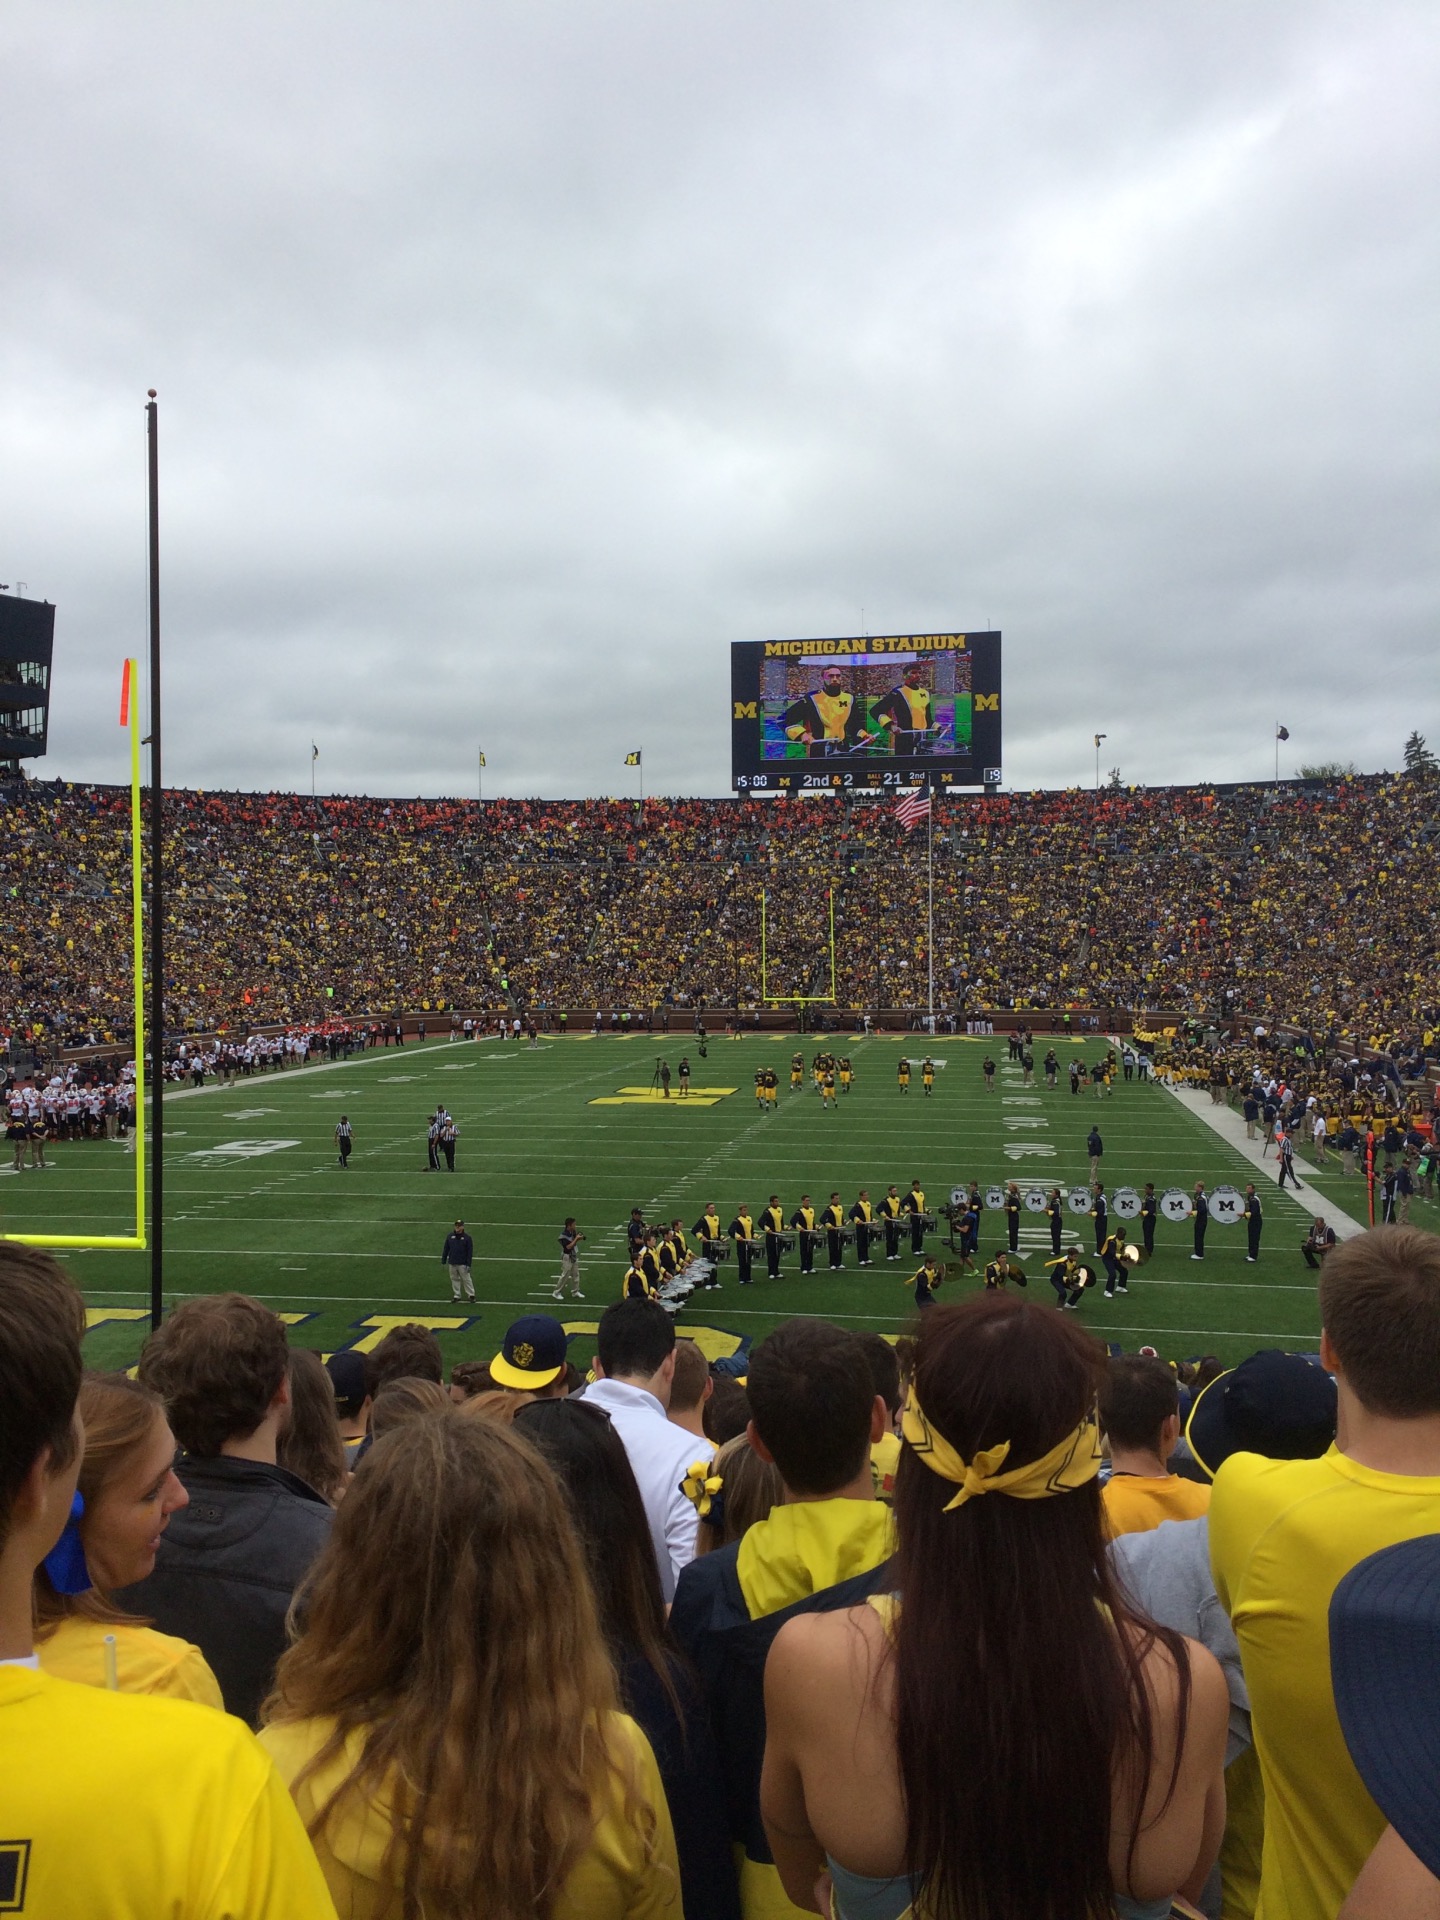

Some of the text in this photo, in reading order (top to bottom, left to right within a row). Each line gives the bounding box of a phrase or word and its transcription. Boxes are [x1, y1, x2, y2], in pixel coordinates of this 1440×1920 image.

[765, 634, 966, 656] MICHIGAN STADIUM
[975, 693, 999, 711] M
[734, 702, 757, 719] M
[803, 773, 853, 787] 2nd & 2
[883, 772, 902, 785] 21
[941, 773, 953, 782] M
[989, 769, 1000, 780] 19
[737, 775, 767, 786] 15:00
[779, 777, 790, 786] M
[1353, 1101, 1364, 1111] 77
[1074, 1198, 1085, 1206] M
[1121, 1201, 1134, 1209] M
[1169, 1200, 1184, 1211] M
[1218, 1200, 1235, 1211] M
